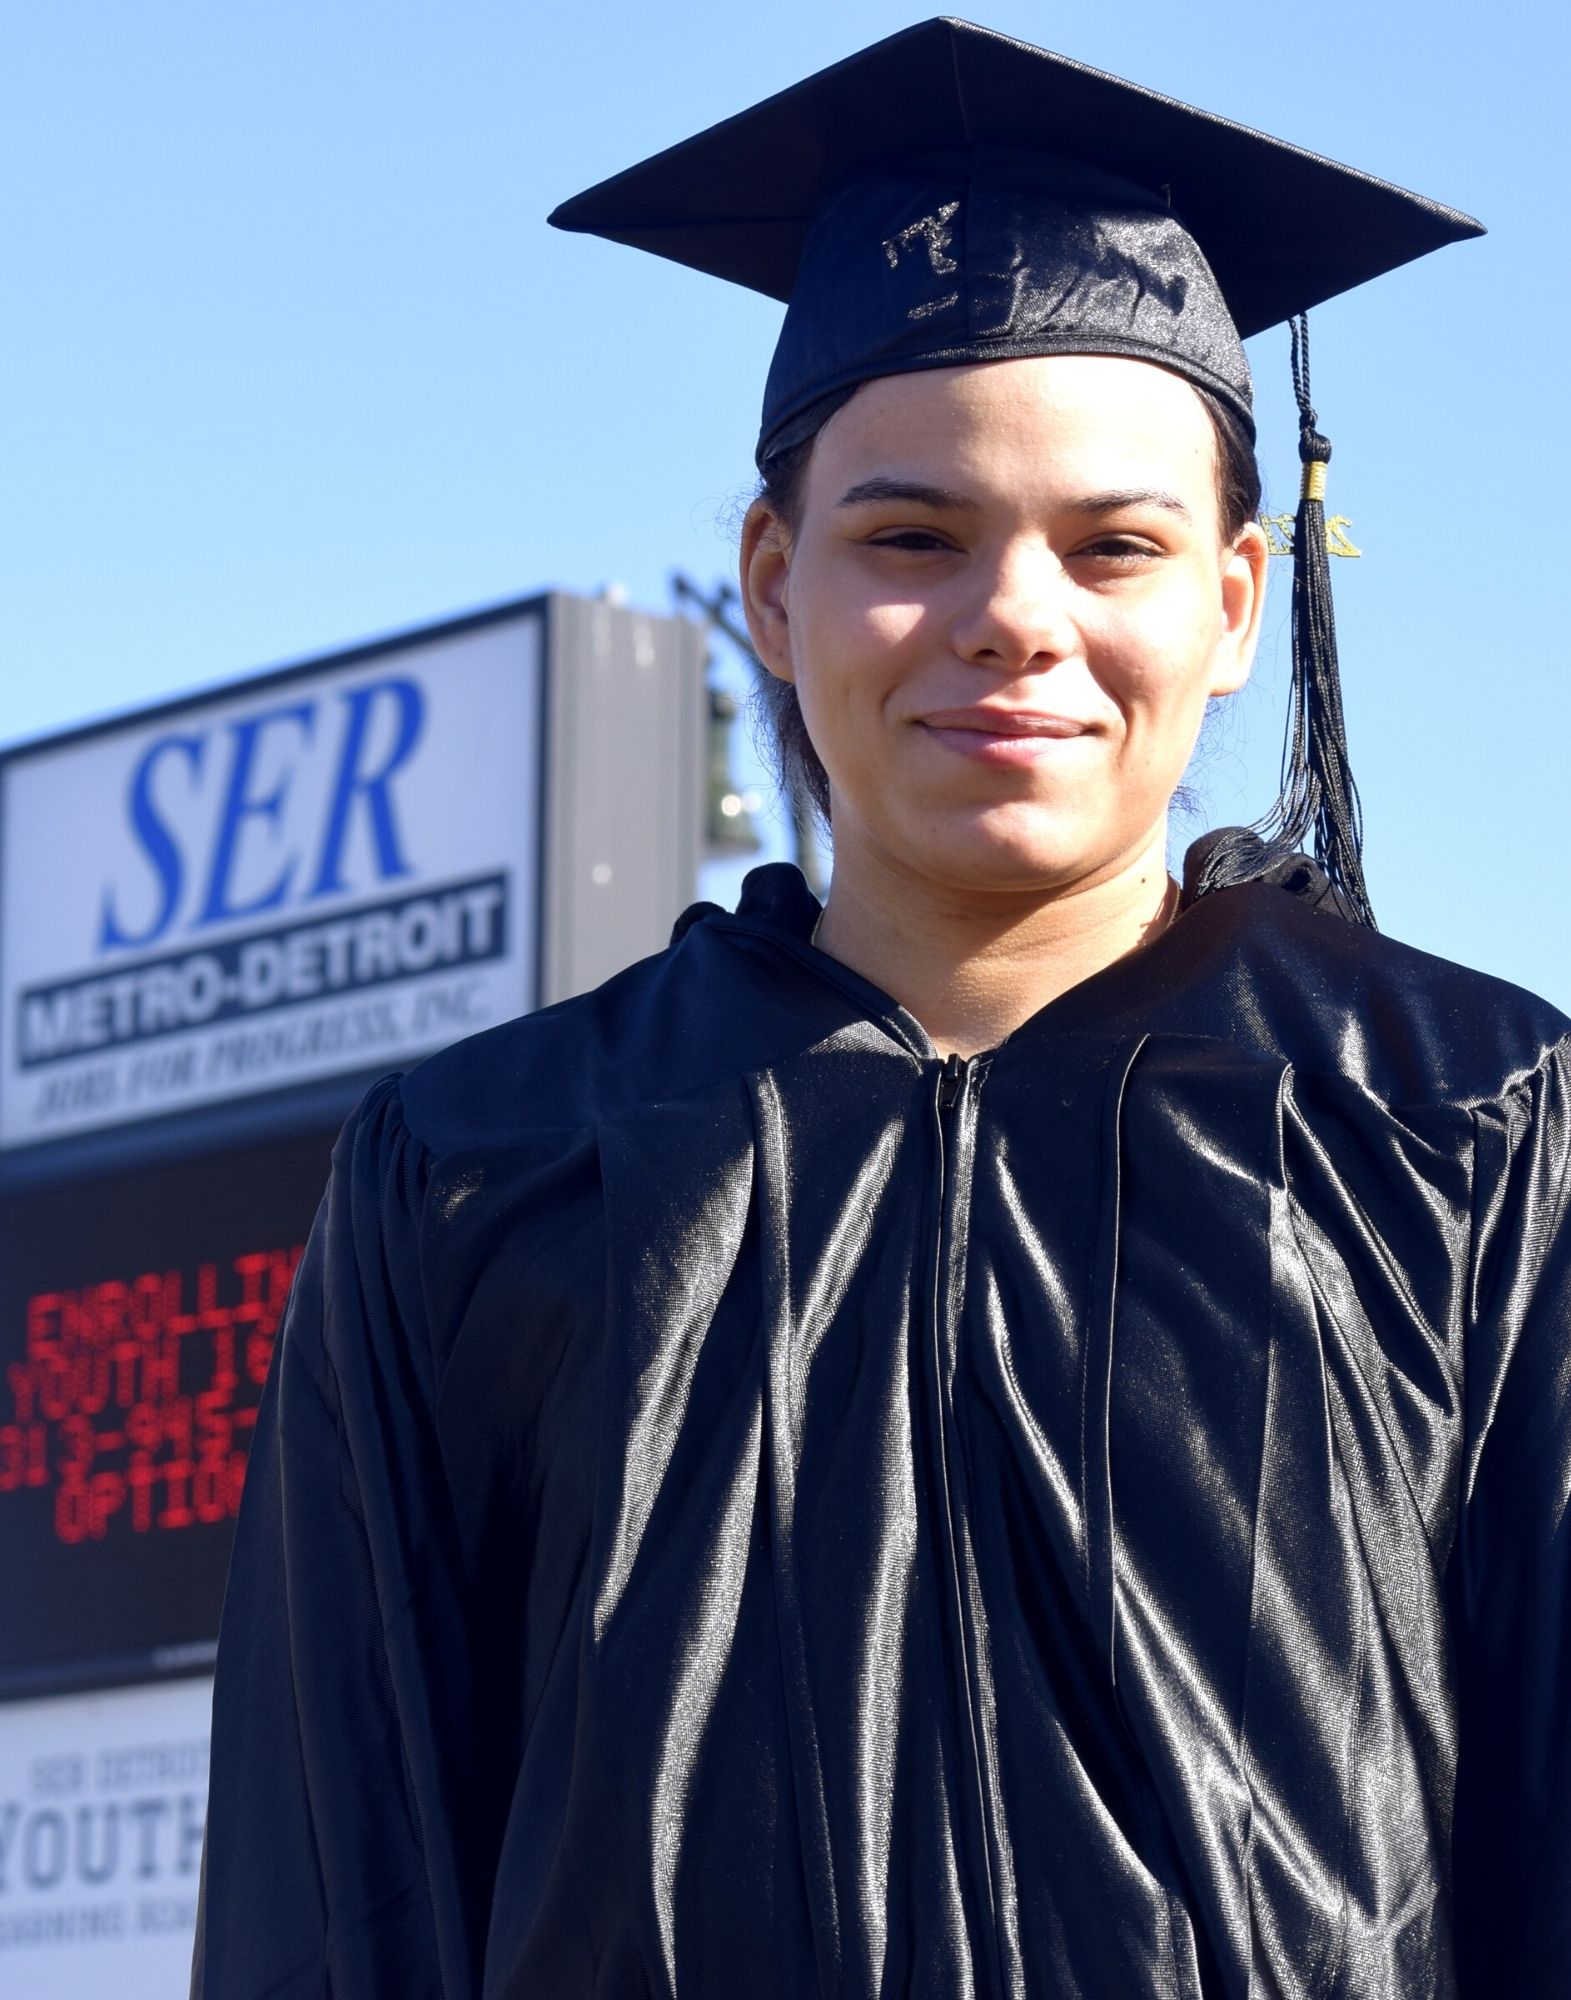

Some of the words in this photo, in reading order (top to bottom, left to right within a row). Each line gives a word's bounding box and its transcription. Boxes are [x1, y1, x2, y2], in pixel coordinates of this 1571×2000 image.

[95, 674, 425, 955] SER
[20, 886, 499, 1062] METRO-DETROIT
[7, 1335, 181, 1424] YOUTH
[27, 1263, 232, 1361] ENROLL
